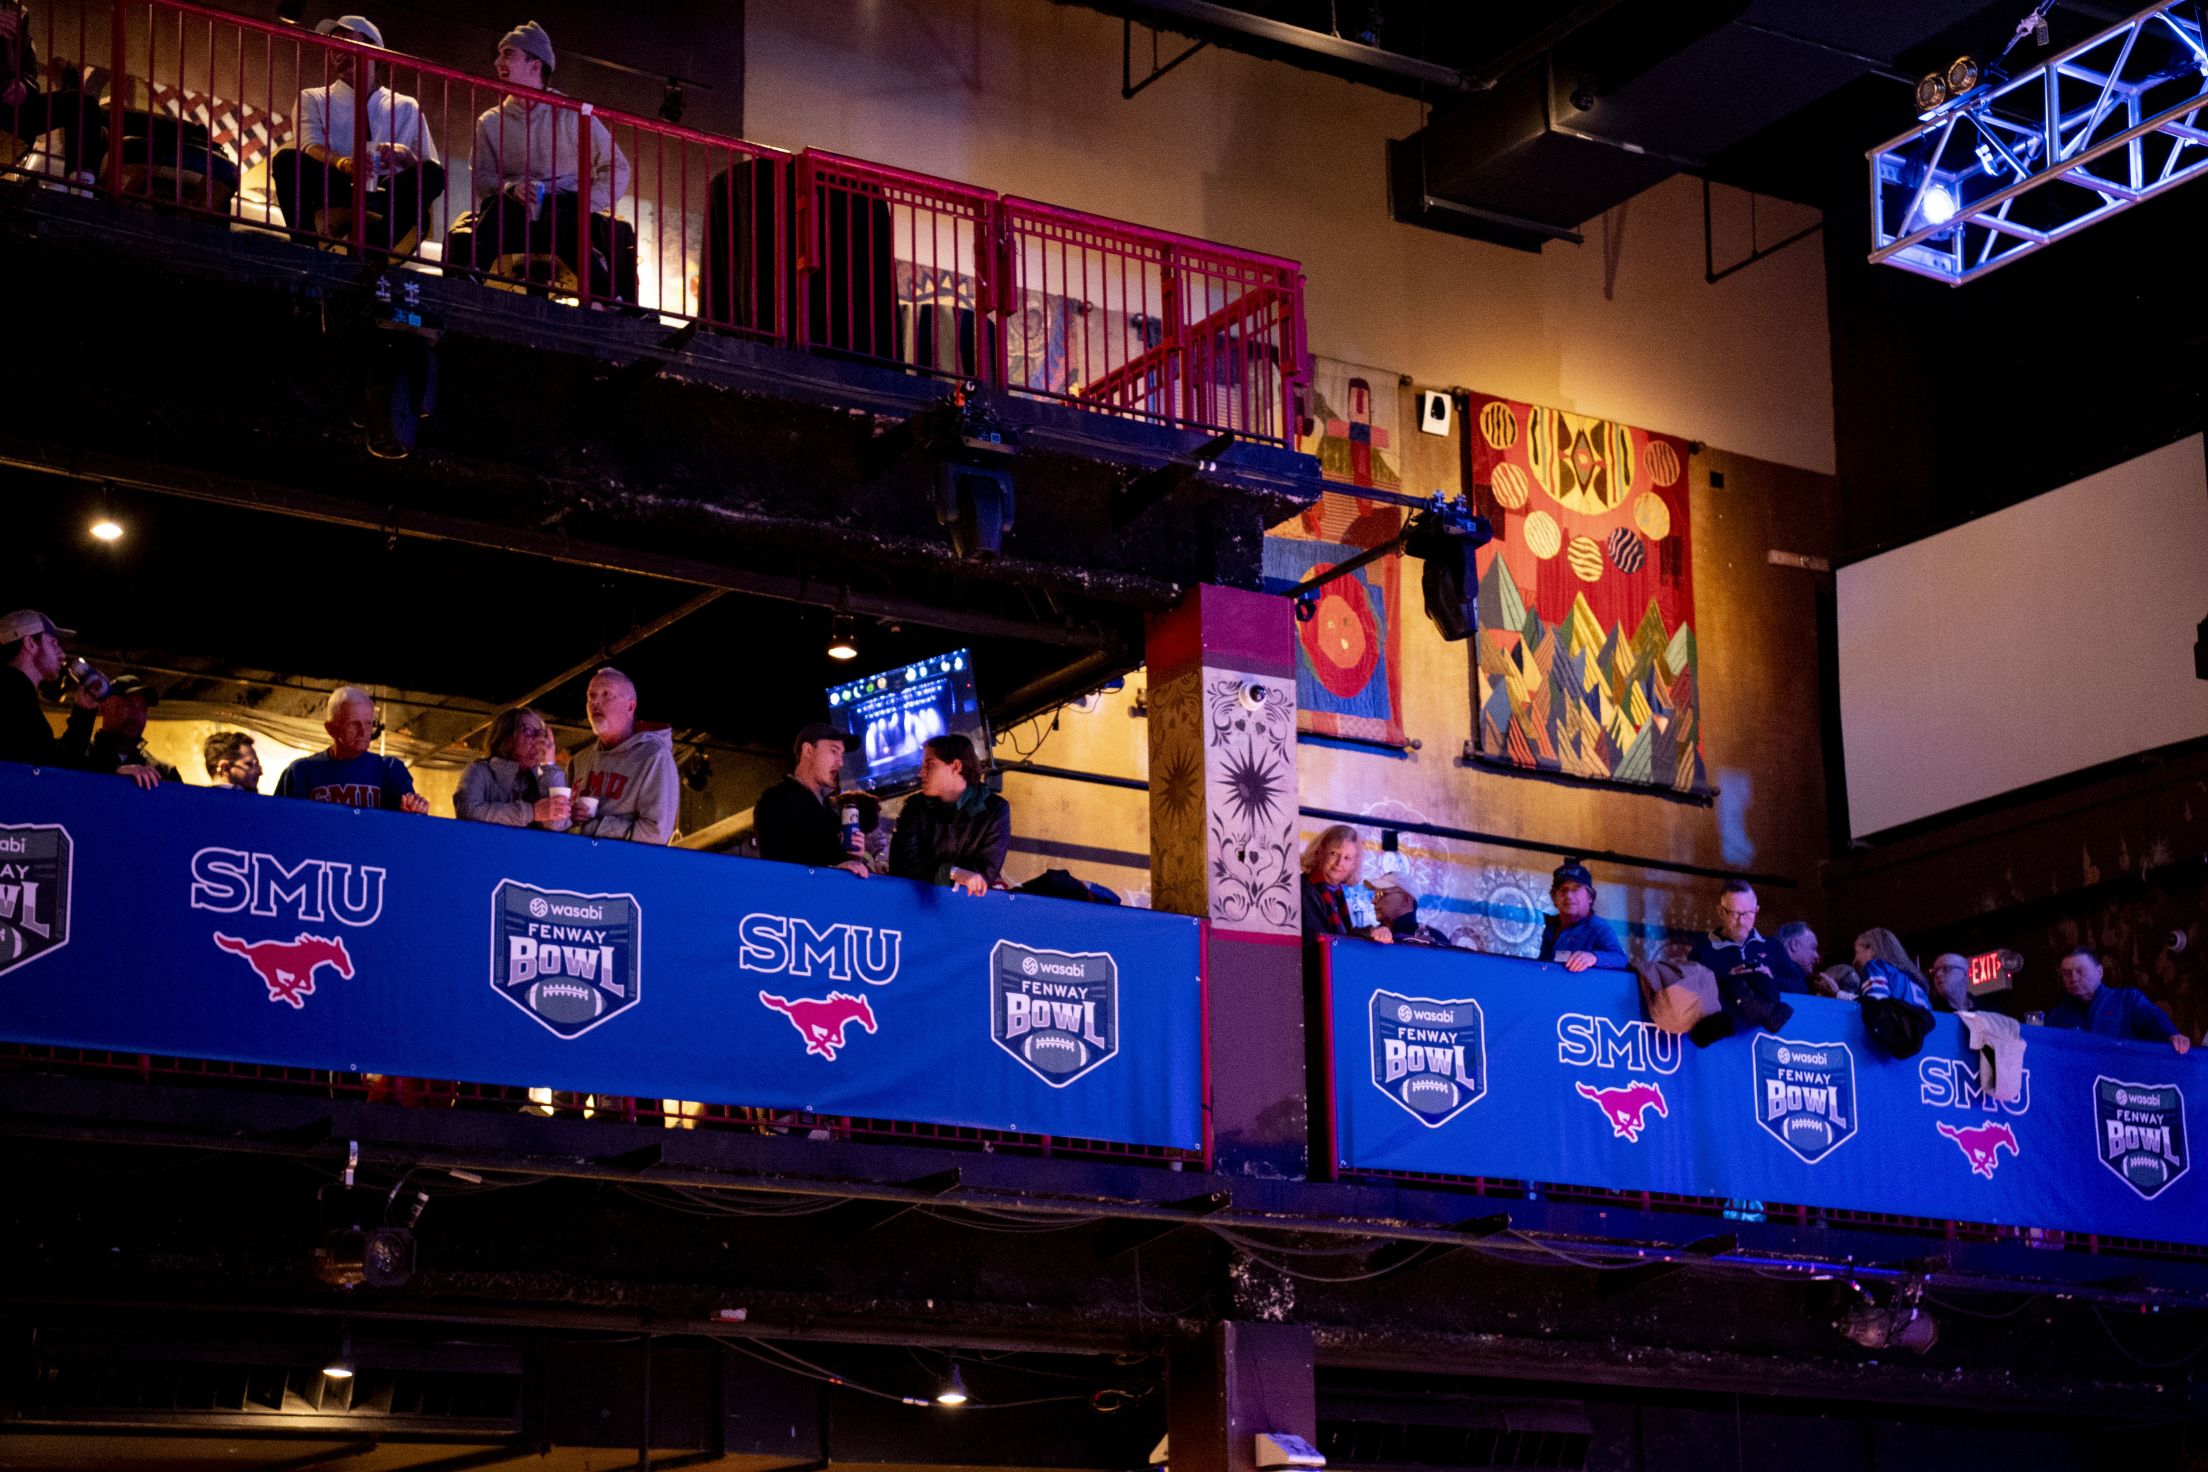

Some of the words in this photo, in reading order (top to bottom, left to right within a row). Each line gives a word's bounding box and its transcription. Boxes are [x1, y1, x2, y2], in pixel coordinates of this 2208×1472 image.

[0, 836, 26, 852] abi
[191, 847, 386, 927] SMU
[550, 903, 603, 920] wasabi
[528, 923, 607, 944] FENWAY
[739, 913, 902, 985] SMU
[508, 935, 625, 998] BOWL
[1040, 962, 1085, 977] wasabi
[1972, 953, 1997, 984] EXIT
[1022, 980, 1088, 999] FENWAY
[1005, 992, 1105, 1050] BOWL
[1414, 1010, 1454, 1023] wasabi
[1398, 1027, 1458, 1044] FENWAY
[1557, 1013, 1681, 1075] SMU
[1384, 1039, 1475, 1091] BOWL
[1791, 1052, 1827, 1066] wasabi
[1778, 1068, 1831, 1085] FENWAY
[1766, 1079, 1847, 1130] BOWL
[2128, 1093, 2160, 1107] wasabi
[2116, 1109, 2165, 1125] FENWAY
[2106, 1119, 2180, 1167] BOWL
